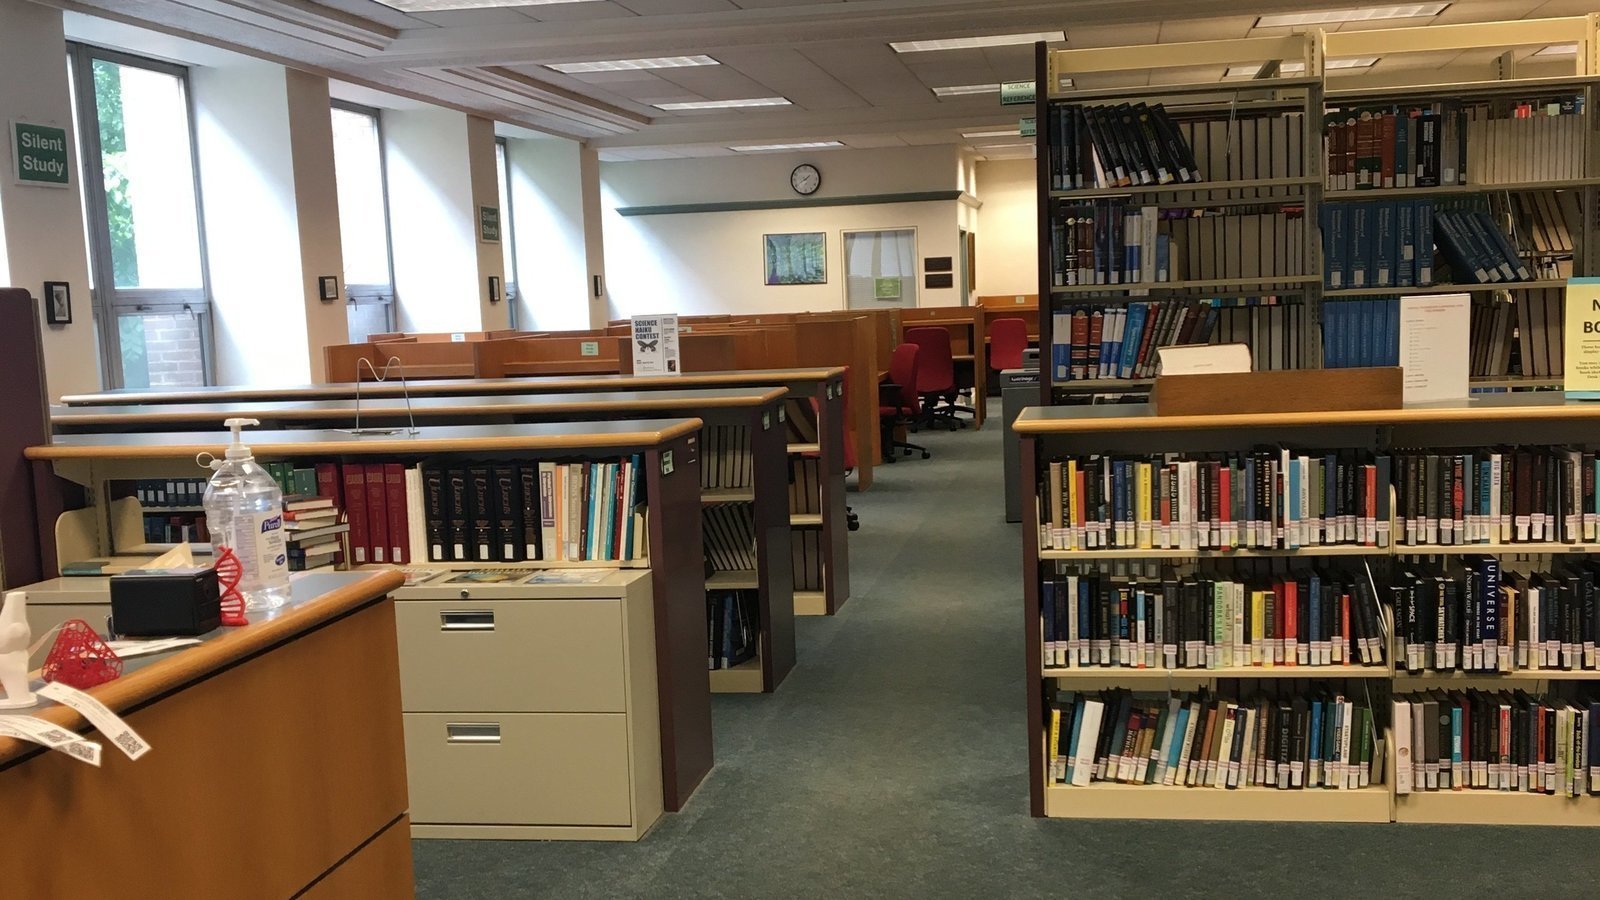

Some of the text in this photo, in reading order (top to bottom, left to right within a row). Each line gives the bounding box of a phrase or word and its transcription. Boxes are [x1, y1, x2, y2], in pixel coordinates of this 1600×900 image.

[21, 132, 63, 152] Silent
[22, 155, 64, 177] Study
[1216, 586, 1224, 624] PANDORA'S
[1486, 564, 1497, 630] UNIVERSE
[1585, 581, 1593, 618] GALAXY
[1281, 727, 1289, 762] DIGITIZ
